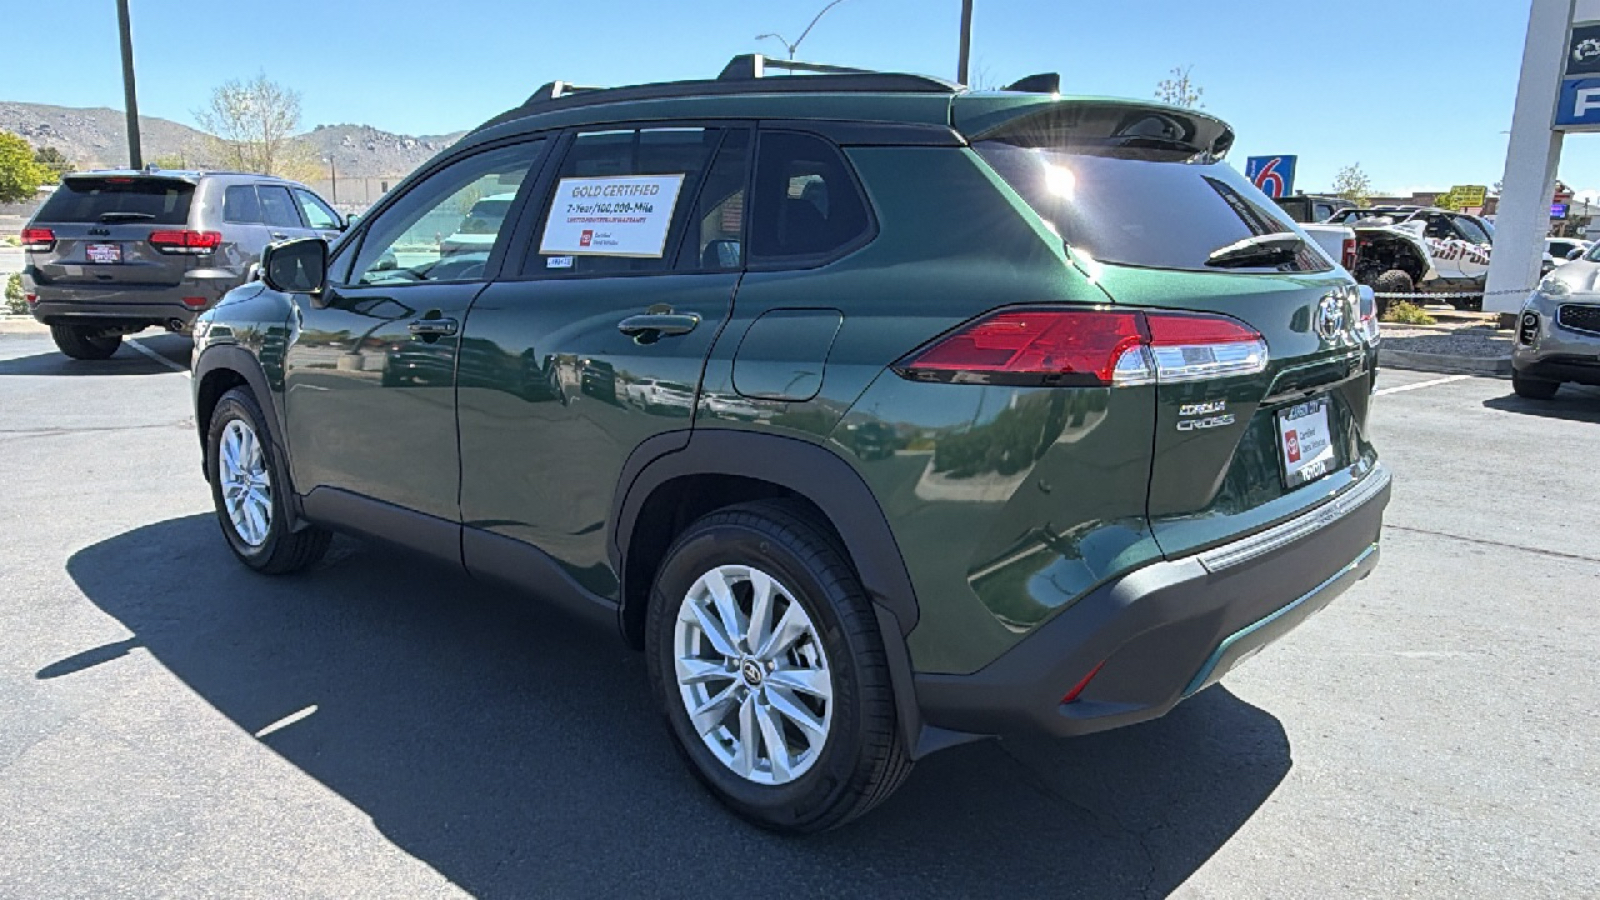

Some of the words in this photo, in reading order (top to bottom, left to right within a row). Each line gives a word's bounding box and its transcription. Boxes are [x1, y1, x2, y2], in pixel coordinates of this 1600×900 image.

[1254, 157, 1284, 199] 6
[572, 185, 601, 197] GOLD
[603, 184, 659, 196] CERTIFIED
[567, 202, 653, 214] 7-Year/100,000-Mile
[1177, 414, 1235, 430] CROSS
